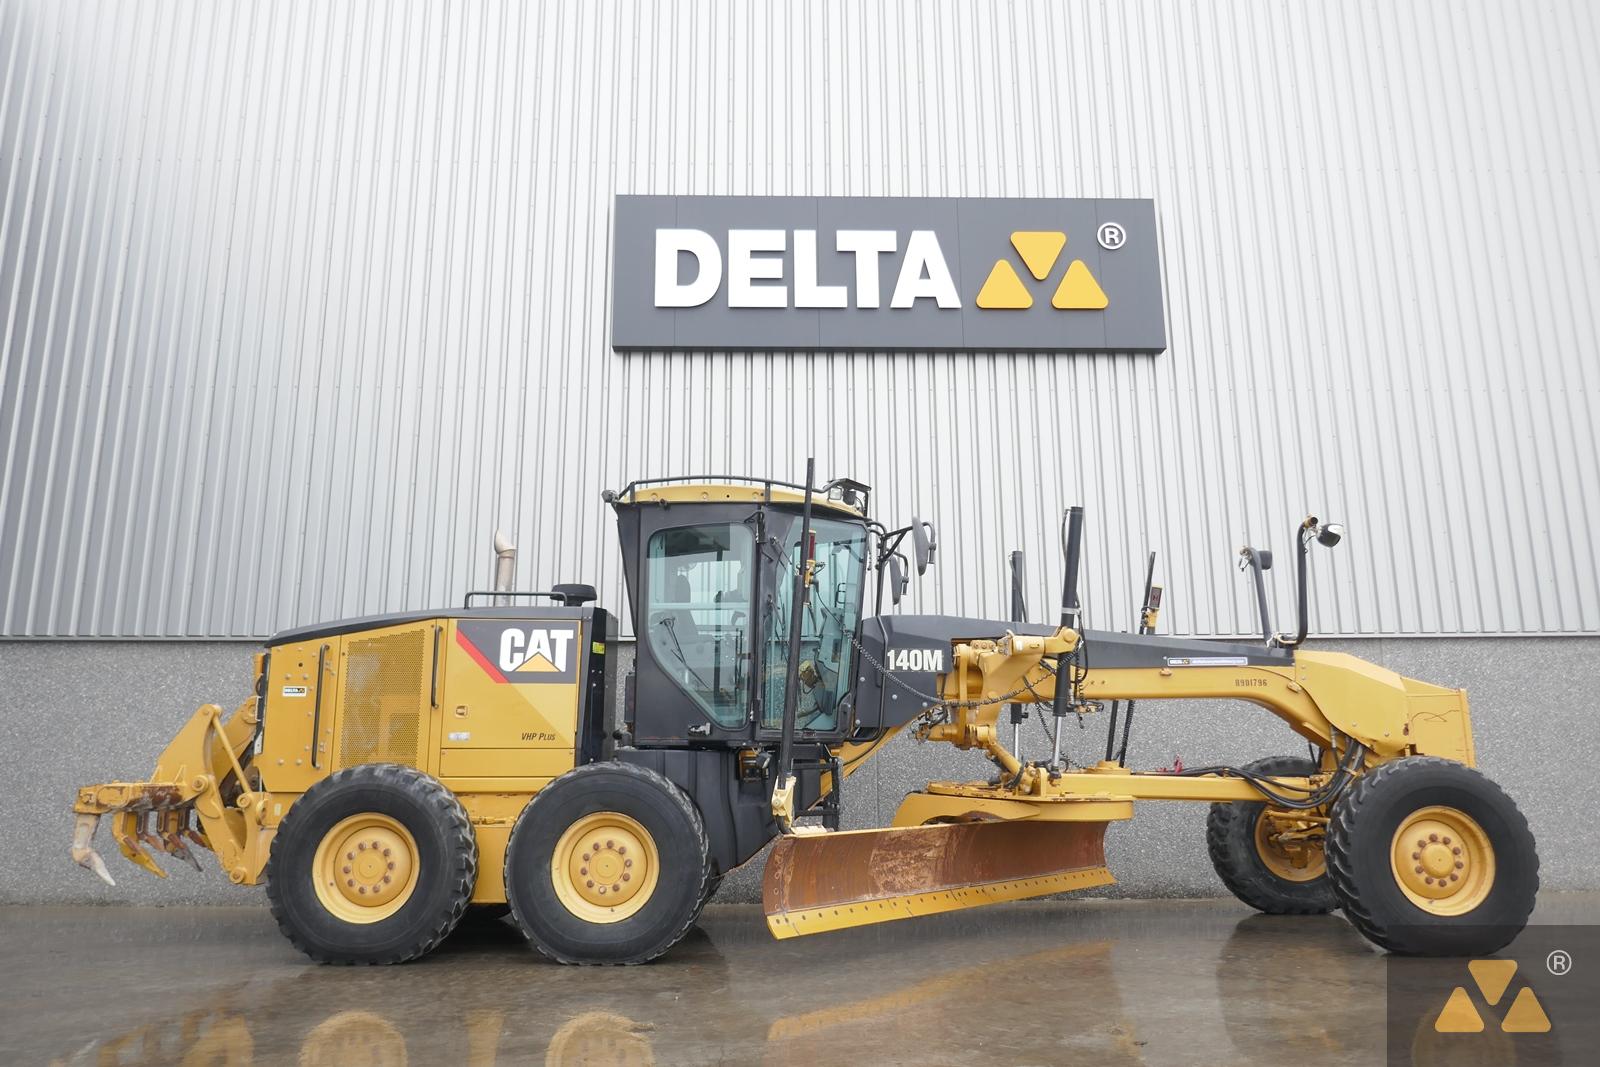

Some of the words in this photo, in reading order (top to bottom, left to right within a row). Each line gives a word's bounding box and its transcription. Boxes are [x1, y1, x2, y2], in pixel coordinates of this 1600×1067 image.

[653, 227, 963, 309] DELTA
[499, 627, 575, 673] CAT
[887, 649, 943, 672] 140M
[521, 732, 537, 741] VHP
